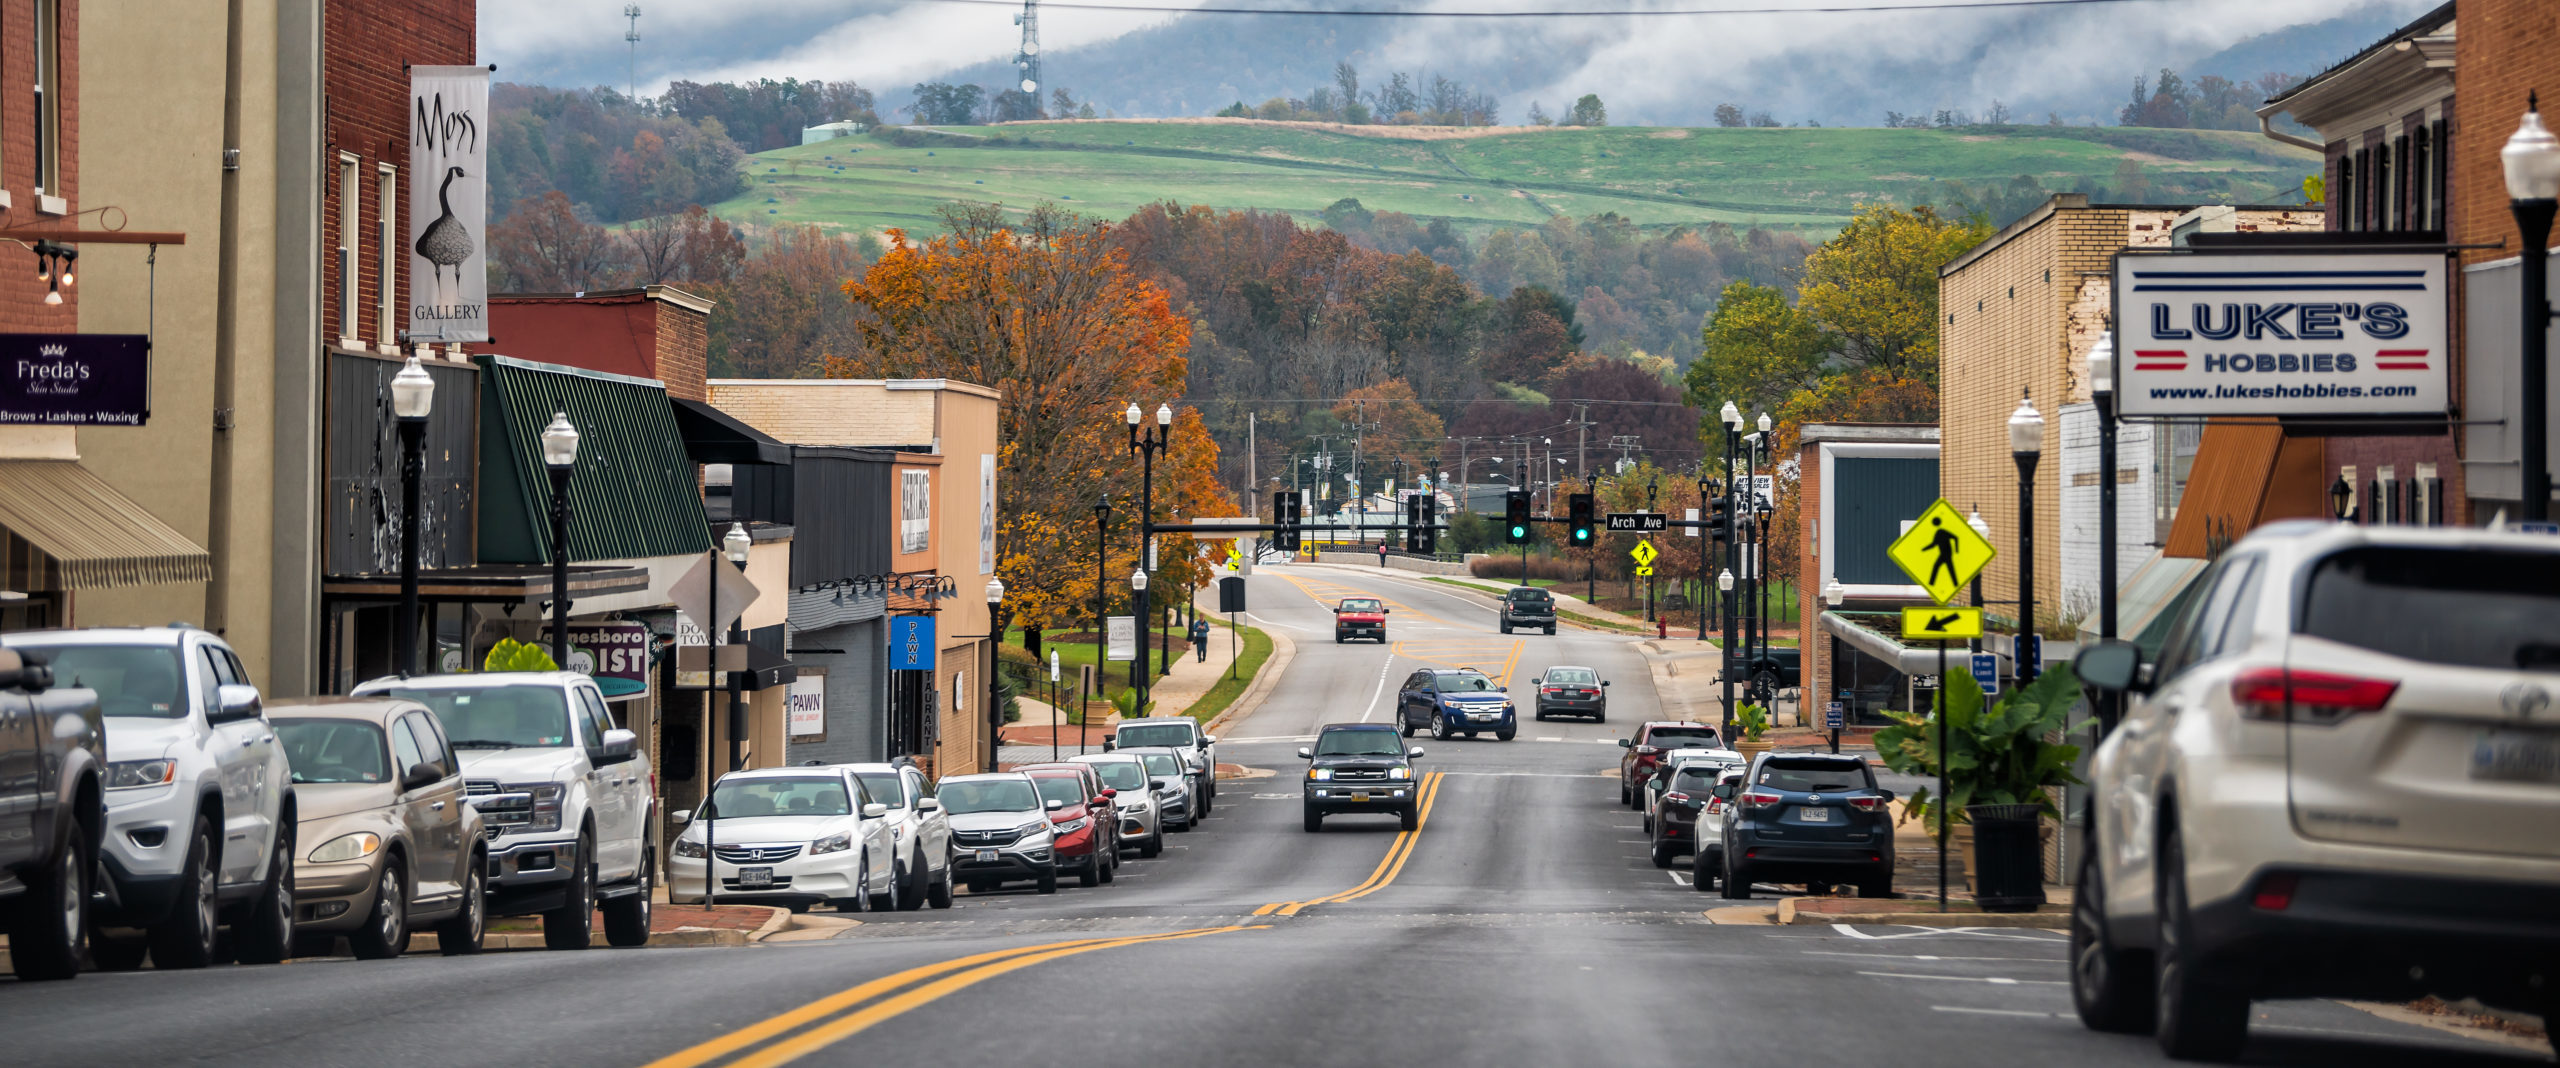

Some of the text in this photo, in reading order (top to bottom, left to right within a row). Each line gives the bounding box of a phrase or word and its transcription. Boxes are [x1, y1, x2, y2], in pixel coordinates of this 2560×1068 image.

[415, 91, 476, 158] Moss
[415, 304, 481, 320] GALLERY
[2151, 302, 2410, 340] LUKE'S
[18, 360, 90, 379] Freda's
[2204, 353, 2357, 373] HOBBIES
[27, 380, 79, 394] Skin Studio
[2150, 384, 2417, 399] www.lukeshobbies.com
[0, 411, 139, 424] Brows Lashes Waxing
[1612, 516, 1662, 528] Arch Ave
[907, 621, 919, 665] PAWN
[793, 693, 820, 712] PAWN
